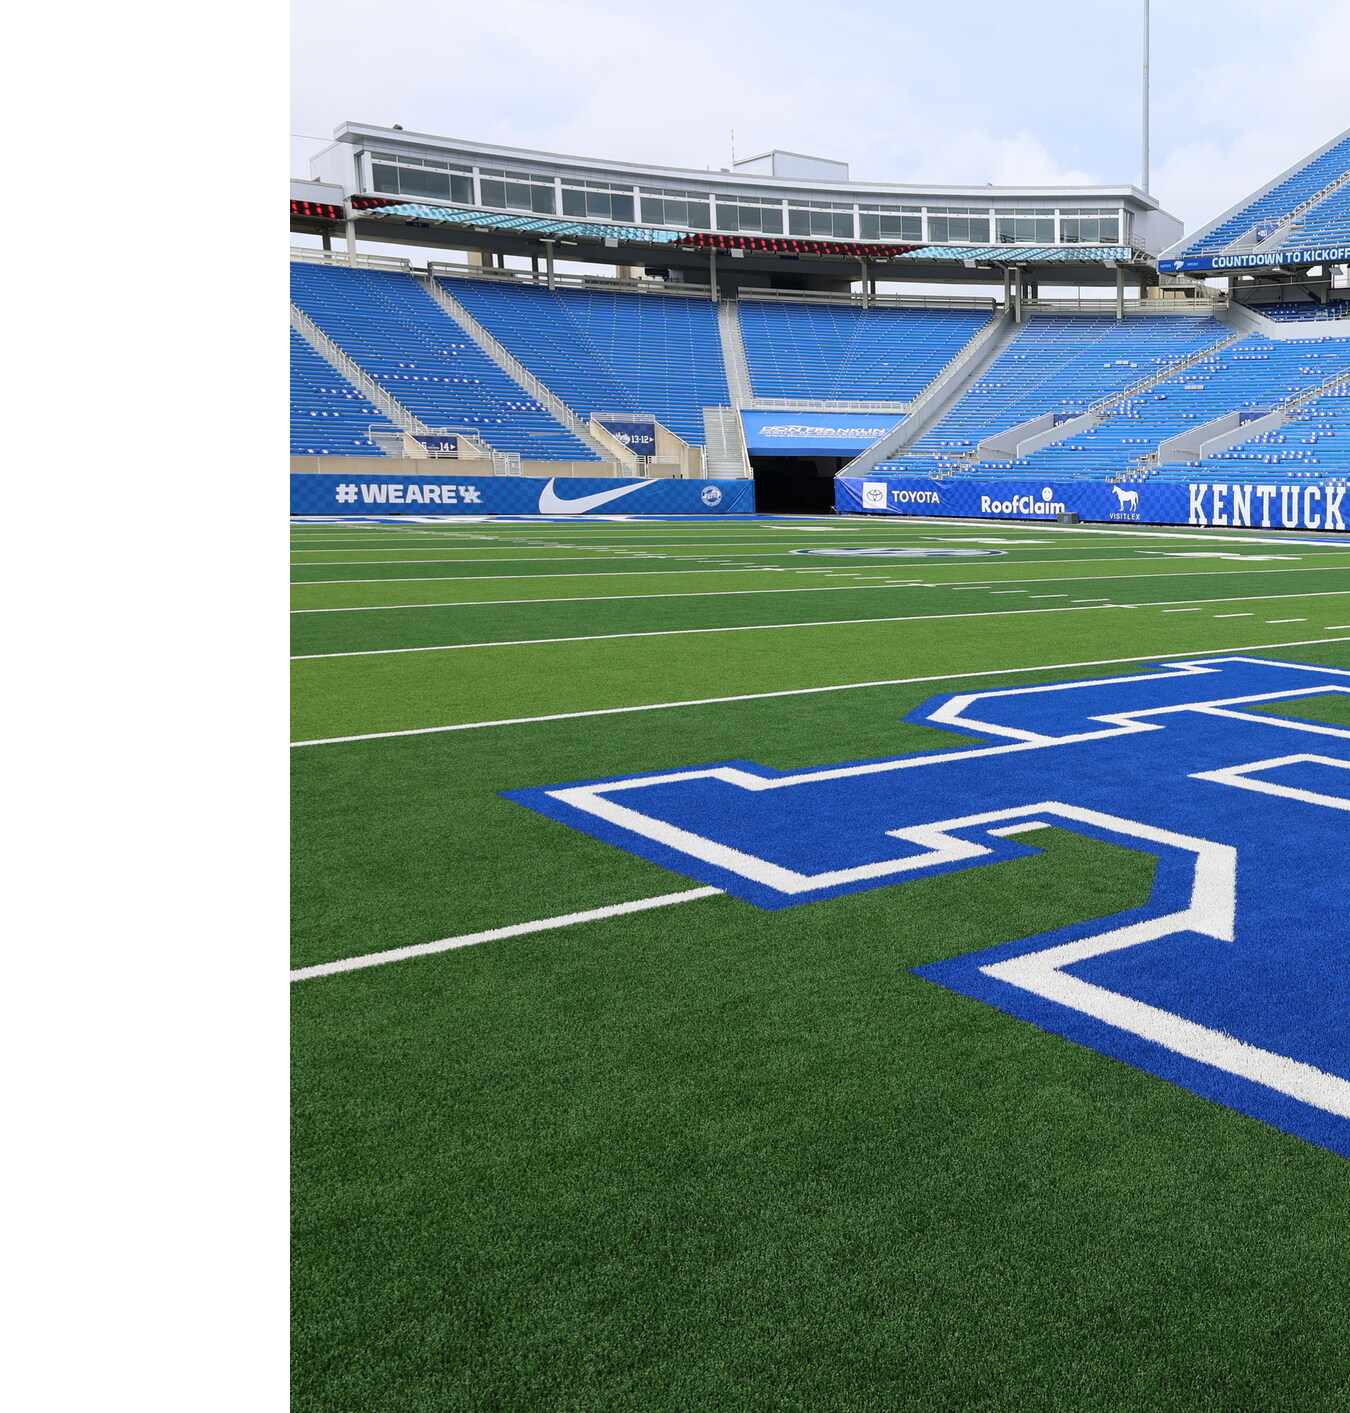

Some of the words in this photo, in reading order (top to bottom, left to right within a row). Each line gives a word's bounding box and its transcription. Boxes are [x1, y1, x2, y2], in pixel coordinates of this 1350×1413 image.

[1211, 253, 1283, 268] COUNTDOWN
[1285, 252, 1300, 262] TO
[631, 435, 649, 444] 13-12
[440, 442, 449, 451] 14
[891, 490, 941, 504] TOYOTA
[981, 487, 1065, 514] RoofClaim
[1109, 513, 1141, 521] VISITLEX
